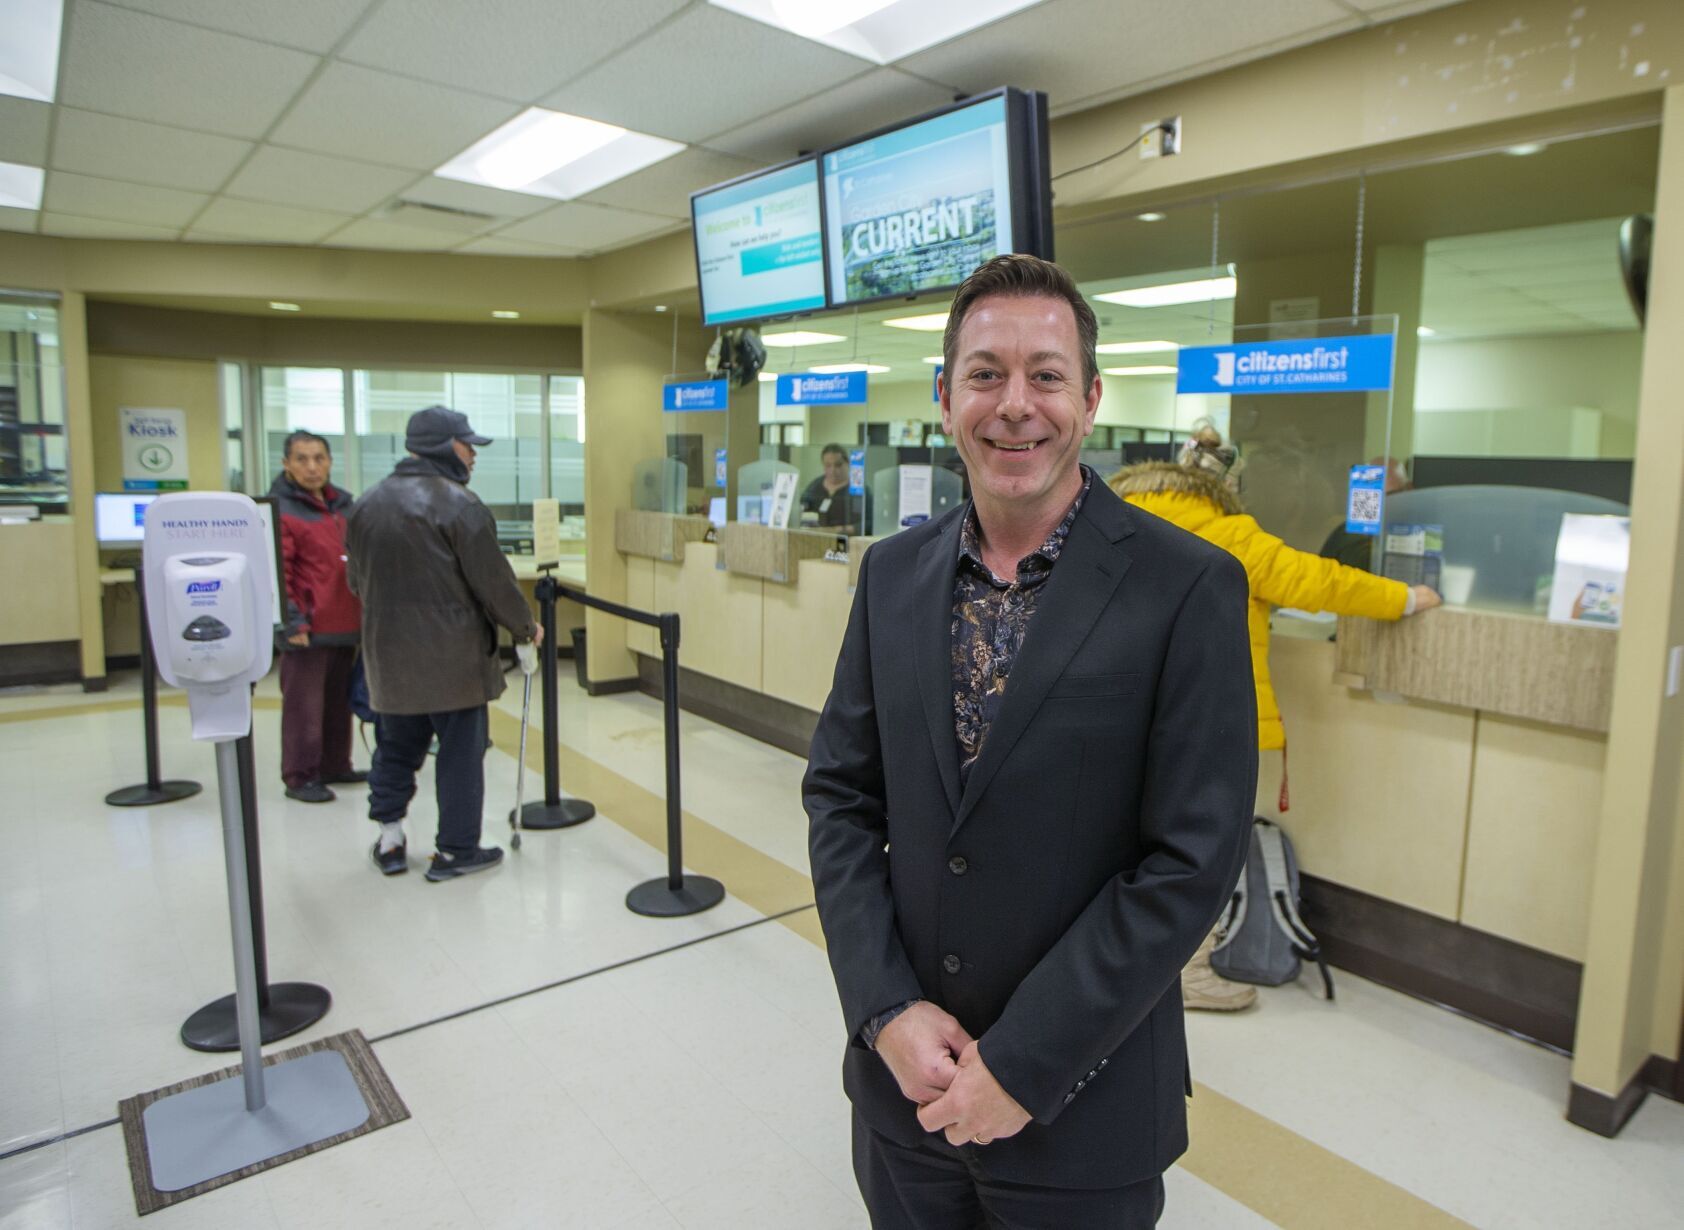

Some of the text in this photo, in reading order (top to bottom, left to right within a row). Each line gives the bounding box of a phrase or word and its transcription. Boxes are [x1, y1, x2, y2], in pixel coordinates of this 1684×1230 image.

[851, 197, 978, 258] CURRENT
[1237, 346, 1348, 373] citizensfirst
[1236, 375, 1256, 385] CITY
[1258, 374, 1271, 385] OF
[128, 423, 177, 437] Kiosk
[161, 519, 249, 529] HEALTHY HANDS
[166, 528, 246, 540] START HERE
